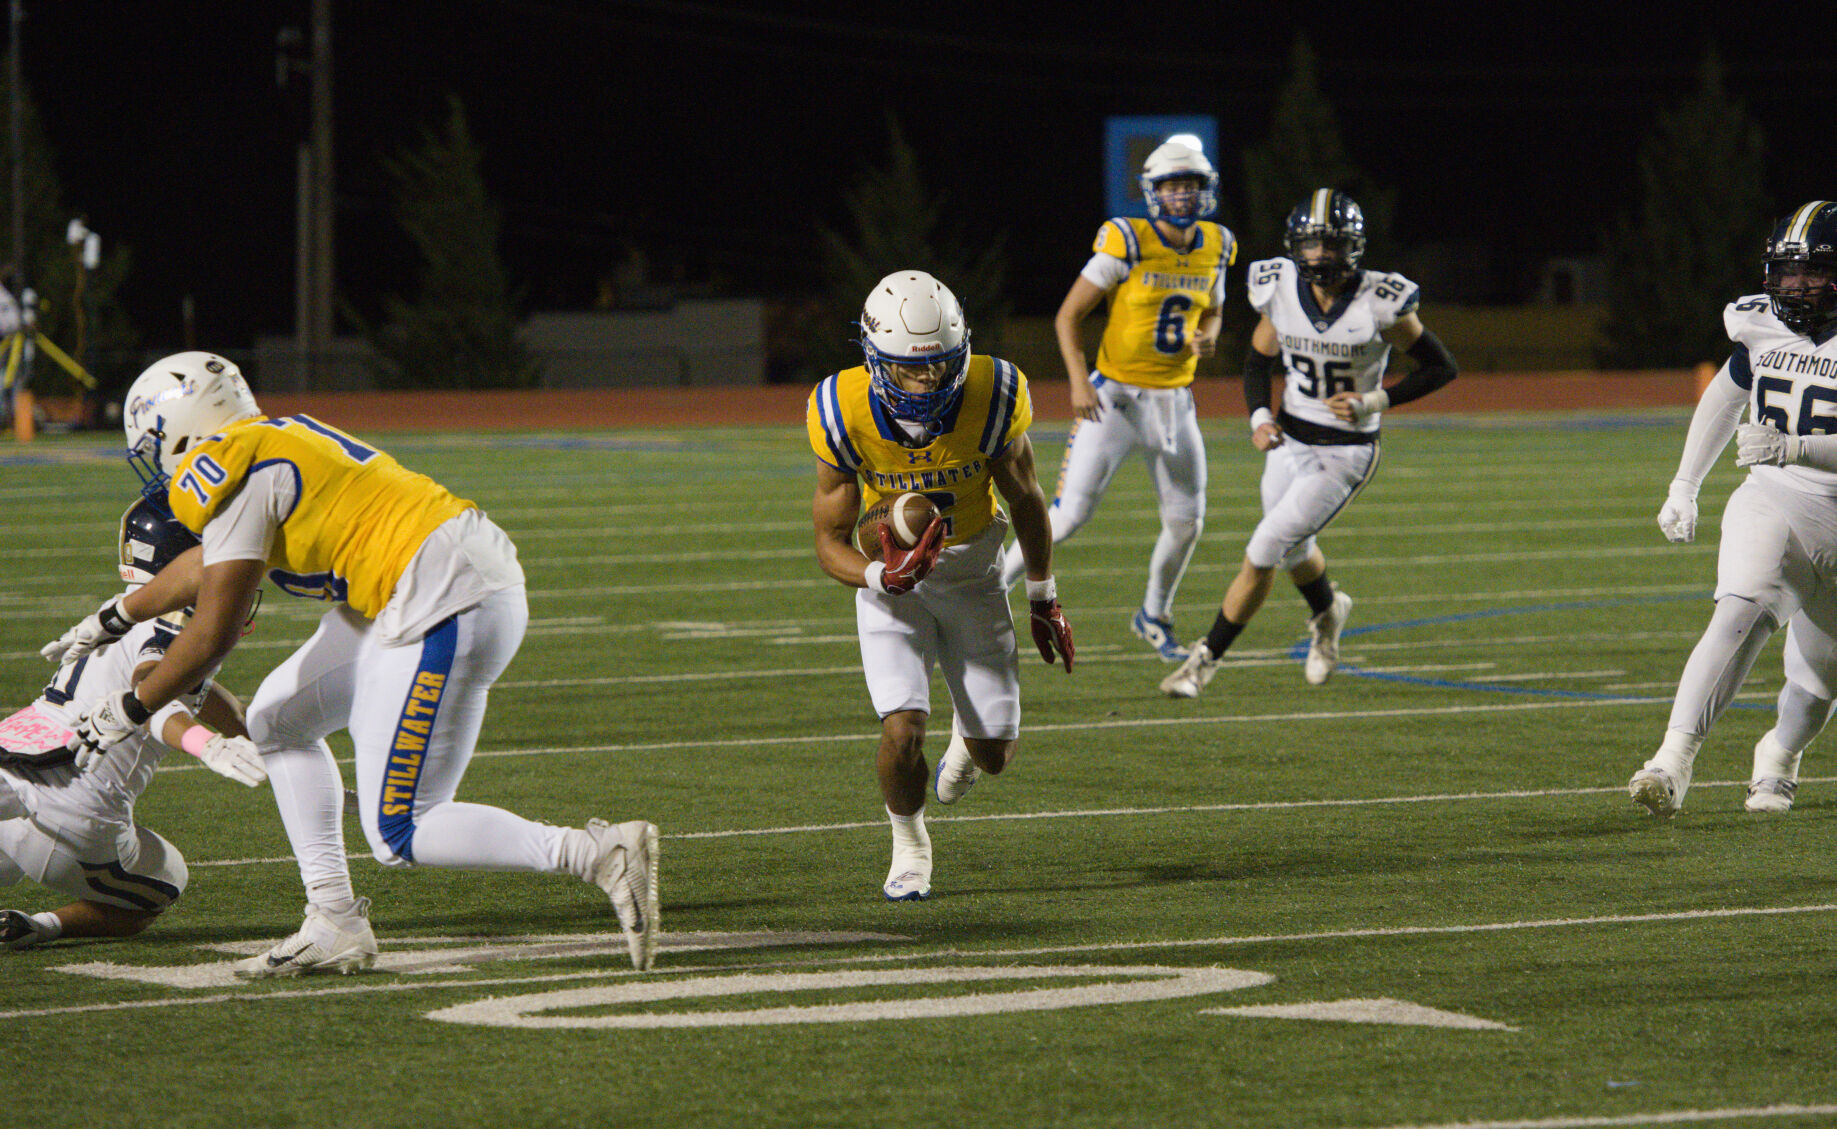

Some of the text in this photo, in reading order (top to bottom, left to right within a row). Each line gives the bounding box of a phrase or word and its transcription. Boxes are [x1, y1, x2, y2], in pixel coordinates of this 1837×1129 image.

[1143, 271, 1210, 291] STILLWATE
[1258, 262, 1283, 286] 96
[1374, 276, 1406, 303] 96
[1153, 293, 1193, 357] 6
[911, 343, 940, 353] Riddell
[1280, 333, 1367, 358] OUTHMOORE
[1291, 352, 1356, 399] 96
[176, 452, 228, 508] 70
[864, 459, 983, 491] STILLWATER
[382, 671, 447, 817] STILLWATER
